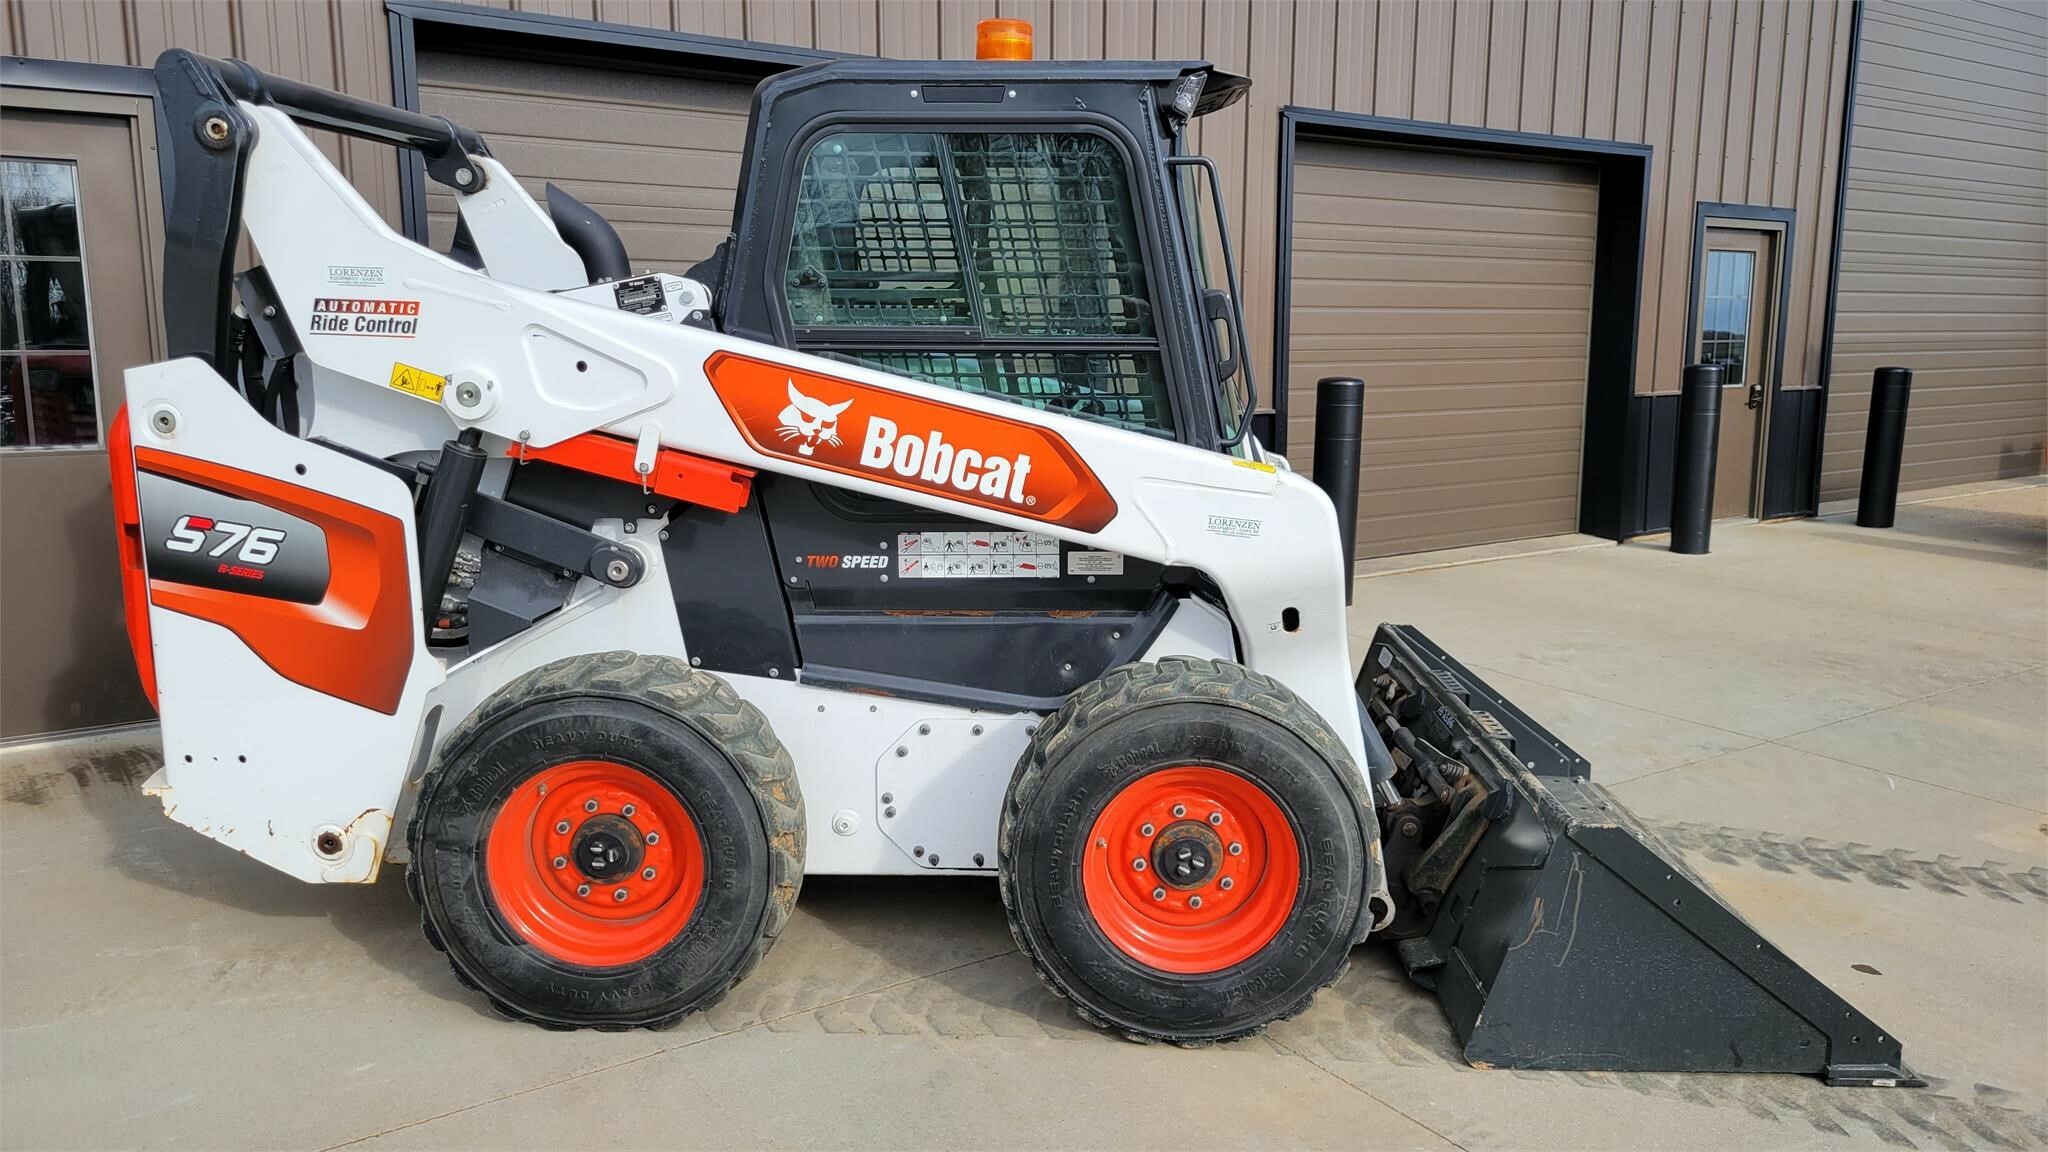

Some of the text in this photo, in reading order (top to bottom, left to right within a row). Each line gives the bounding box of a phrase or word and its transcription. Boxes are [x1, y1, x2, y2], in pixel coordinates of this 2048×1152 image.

[329, 268, 384, 278] LORENZEN
[317, 300, 416, 314] AUTOMATIC
[310, 314, 418, 334] Ride Control
[860, 416, 1031, 504] Bobcat
[1208, 517, 1261, 529] LORENZEN
[164, 514, 287, 566] S76
[806, 555, 889, 569] TWO SPEED
[531, 730, 643, 751] HEAVY DUTY
